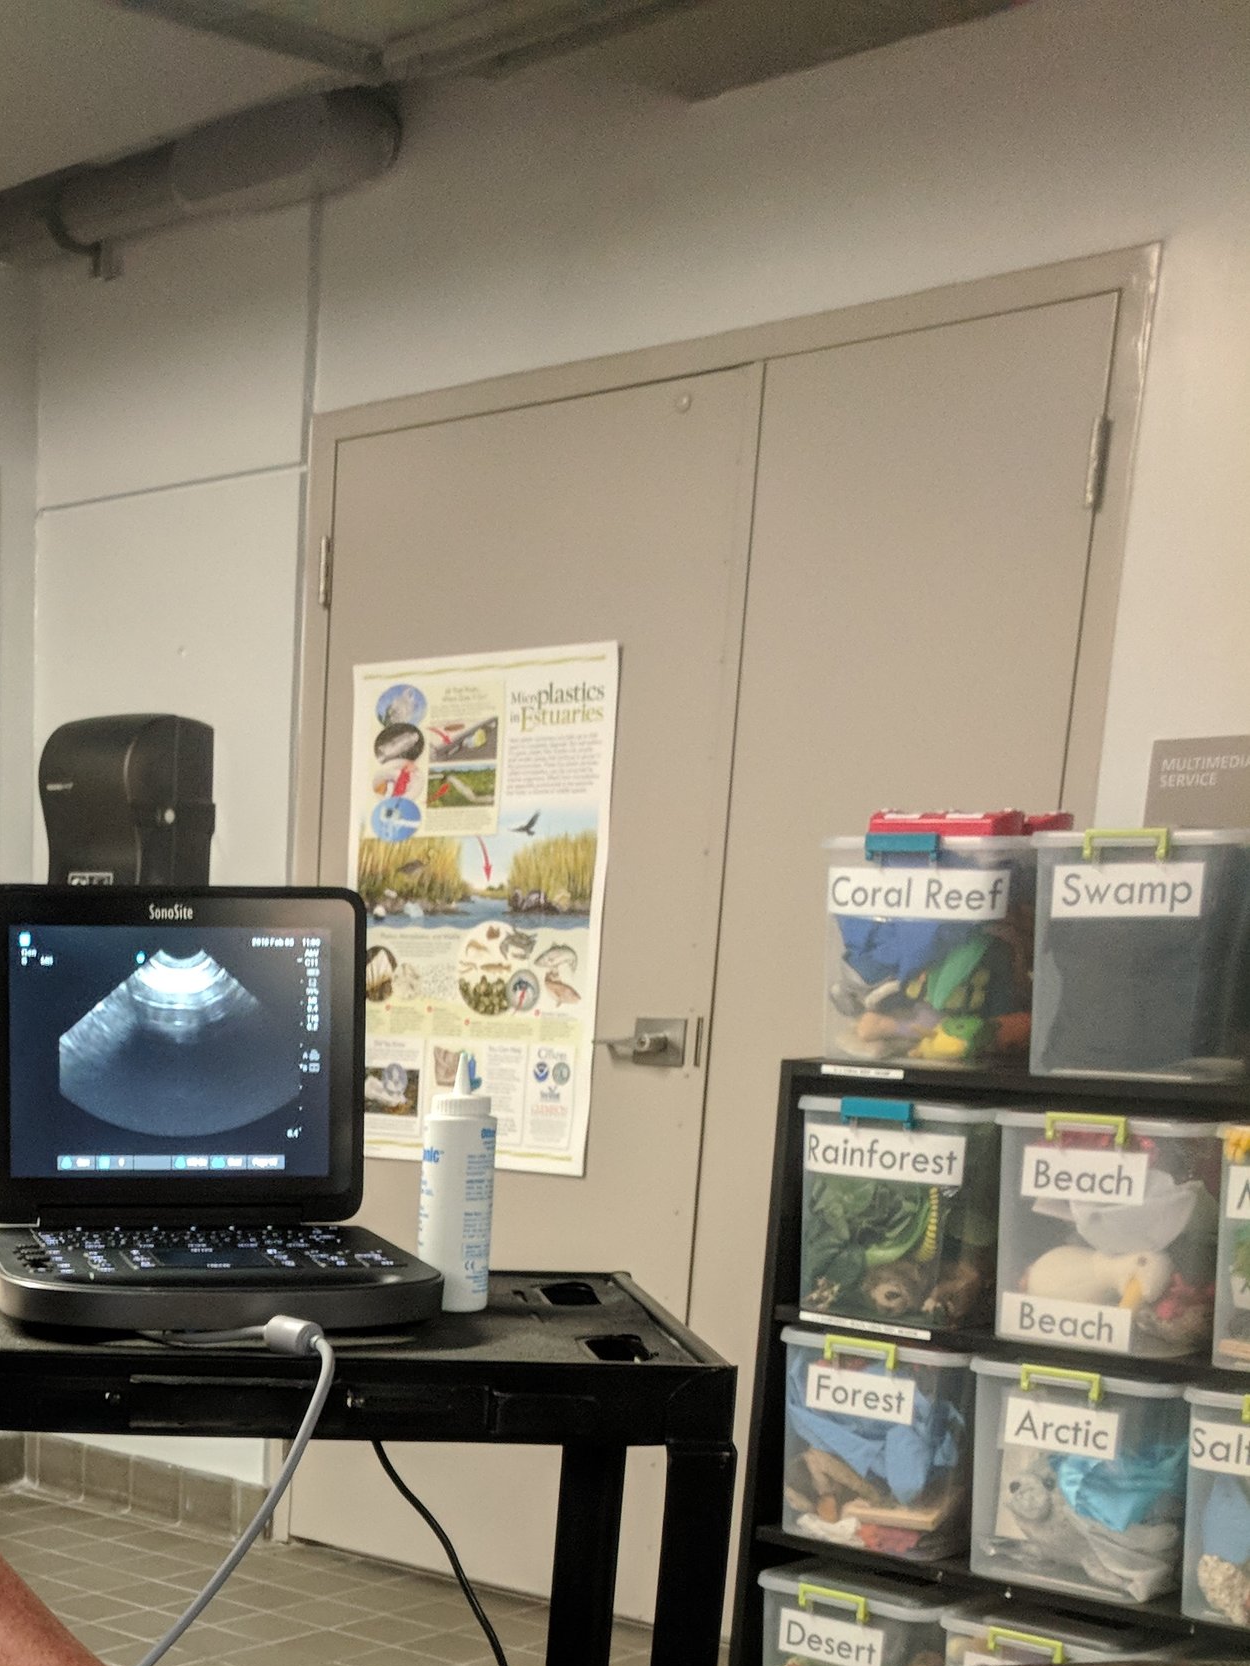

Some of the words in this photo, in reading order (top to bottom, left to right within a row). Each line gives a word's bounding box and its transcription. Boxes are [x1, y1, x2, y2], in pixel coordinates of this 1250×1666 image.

[521, 704, 604, 732] Estuaries
[1160, 772, 1217, 788] SERVICE
[148, 903, 194, 920] SonoSite
[831, 876, 913, 908] Coral
[925, 878, 1004, 911] Reef
[1061, 873, 1193, 912] Swamp
[807, 1133, 958, 1174] Rainforest
[1034, 1159, 1133, 1197] Beach
[1019, 1303, 1114, 1343] Beach
[814, 1374, 905, 1414] Forest
[1014, 1410, 1110, 1450] Arctic
[786, 1620, 877, 1665] Desert
